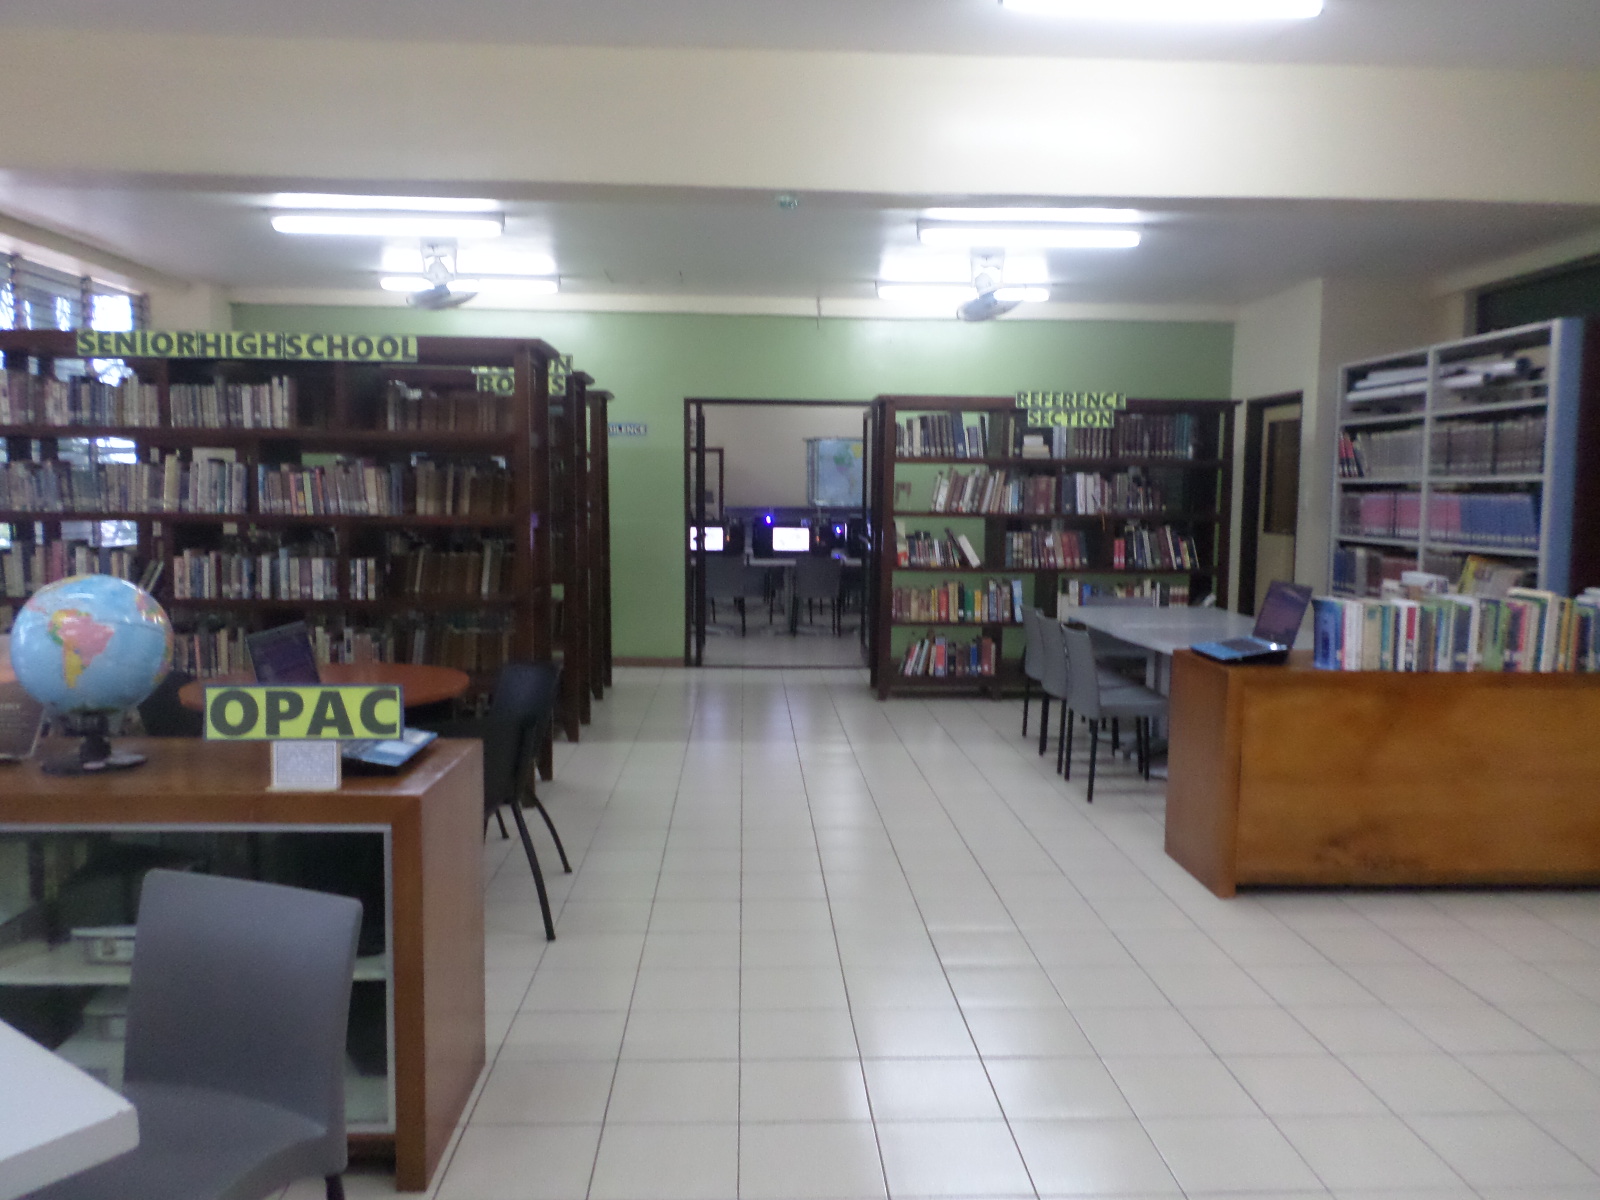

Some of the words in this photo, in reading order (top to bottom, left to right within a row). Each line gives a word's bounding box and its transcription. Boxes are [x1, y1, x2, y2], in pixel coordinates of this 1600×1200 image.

[78, 331, 196, 354] SENIOR
[199, 333, 282, 358] HIGH
[285, 335, 418, 360] SCHOOL
[1016, 391, 1126, 410] REFERENCE
[1028, 410, 1113, 428] SECTION
[209, 689, 397, 737] OPAC
